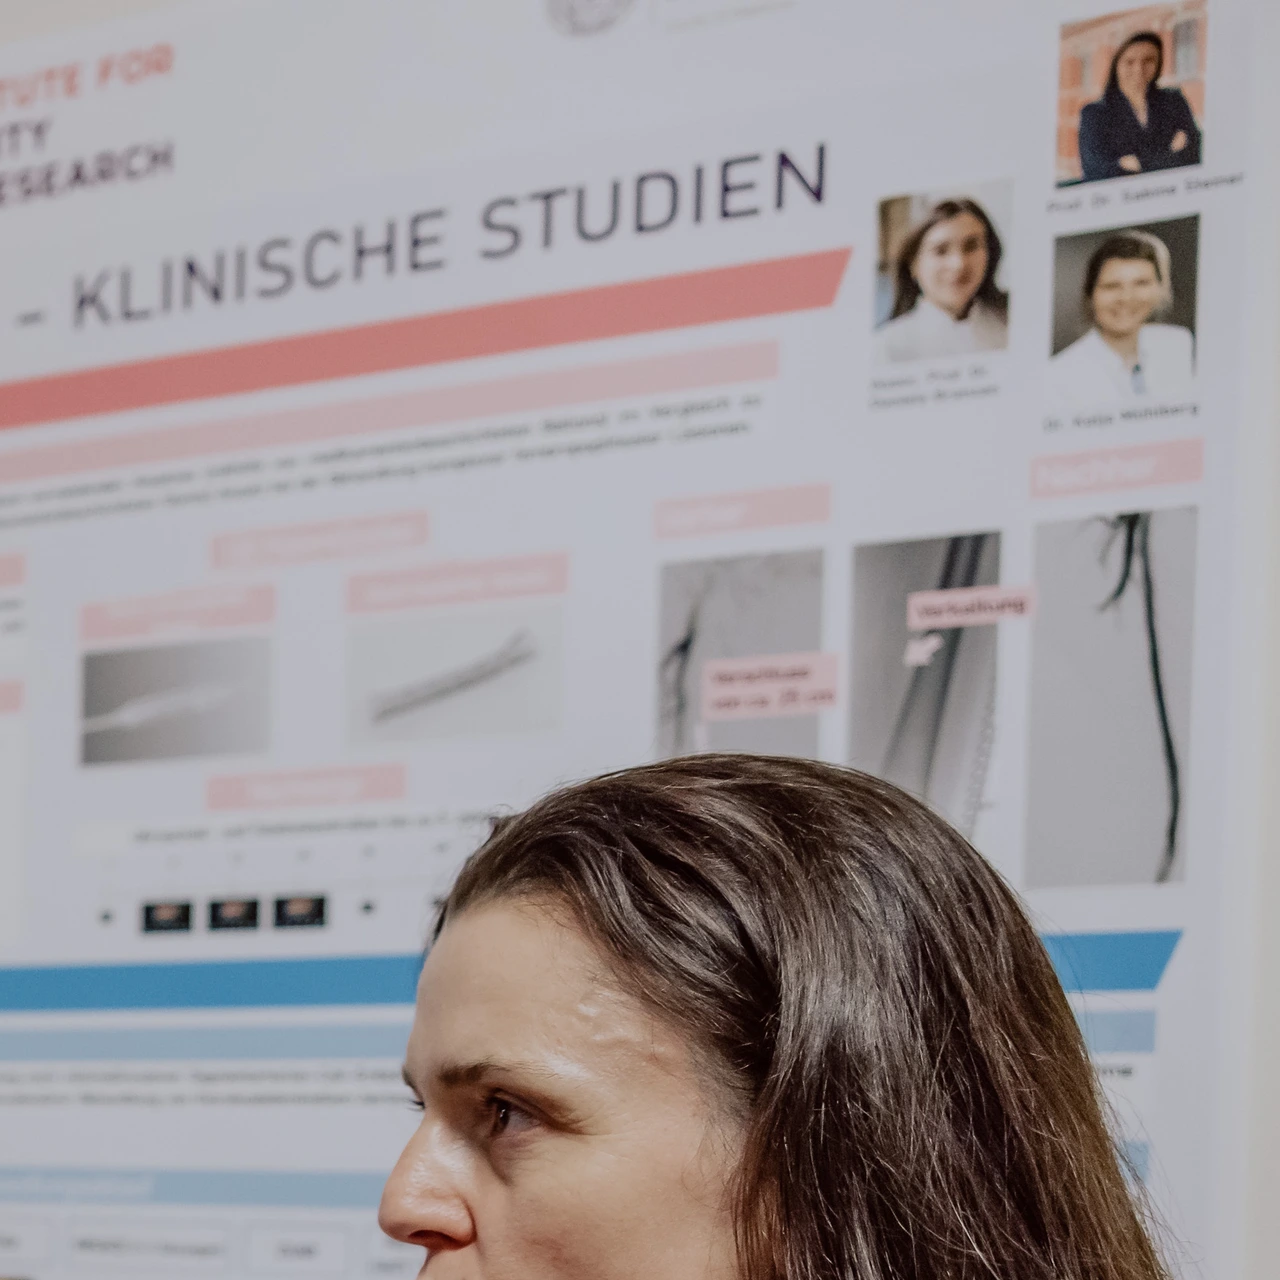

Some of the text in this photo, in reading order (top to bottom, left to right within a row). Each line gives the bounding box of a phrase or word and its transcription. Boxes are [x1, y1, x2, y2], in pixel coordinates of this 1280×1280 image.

[96, 42, 176, 90] FOR
[71, 208, 450, 332] KLINISCHE
[479, 142, 828, 260] STUDIEN
